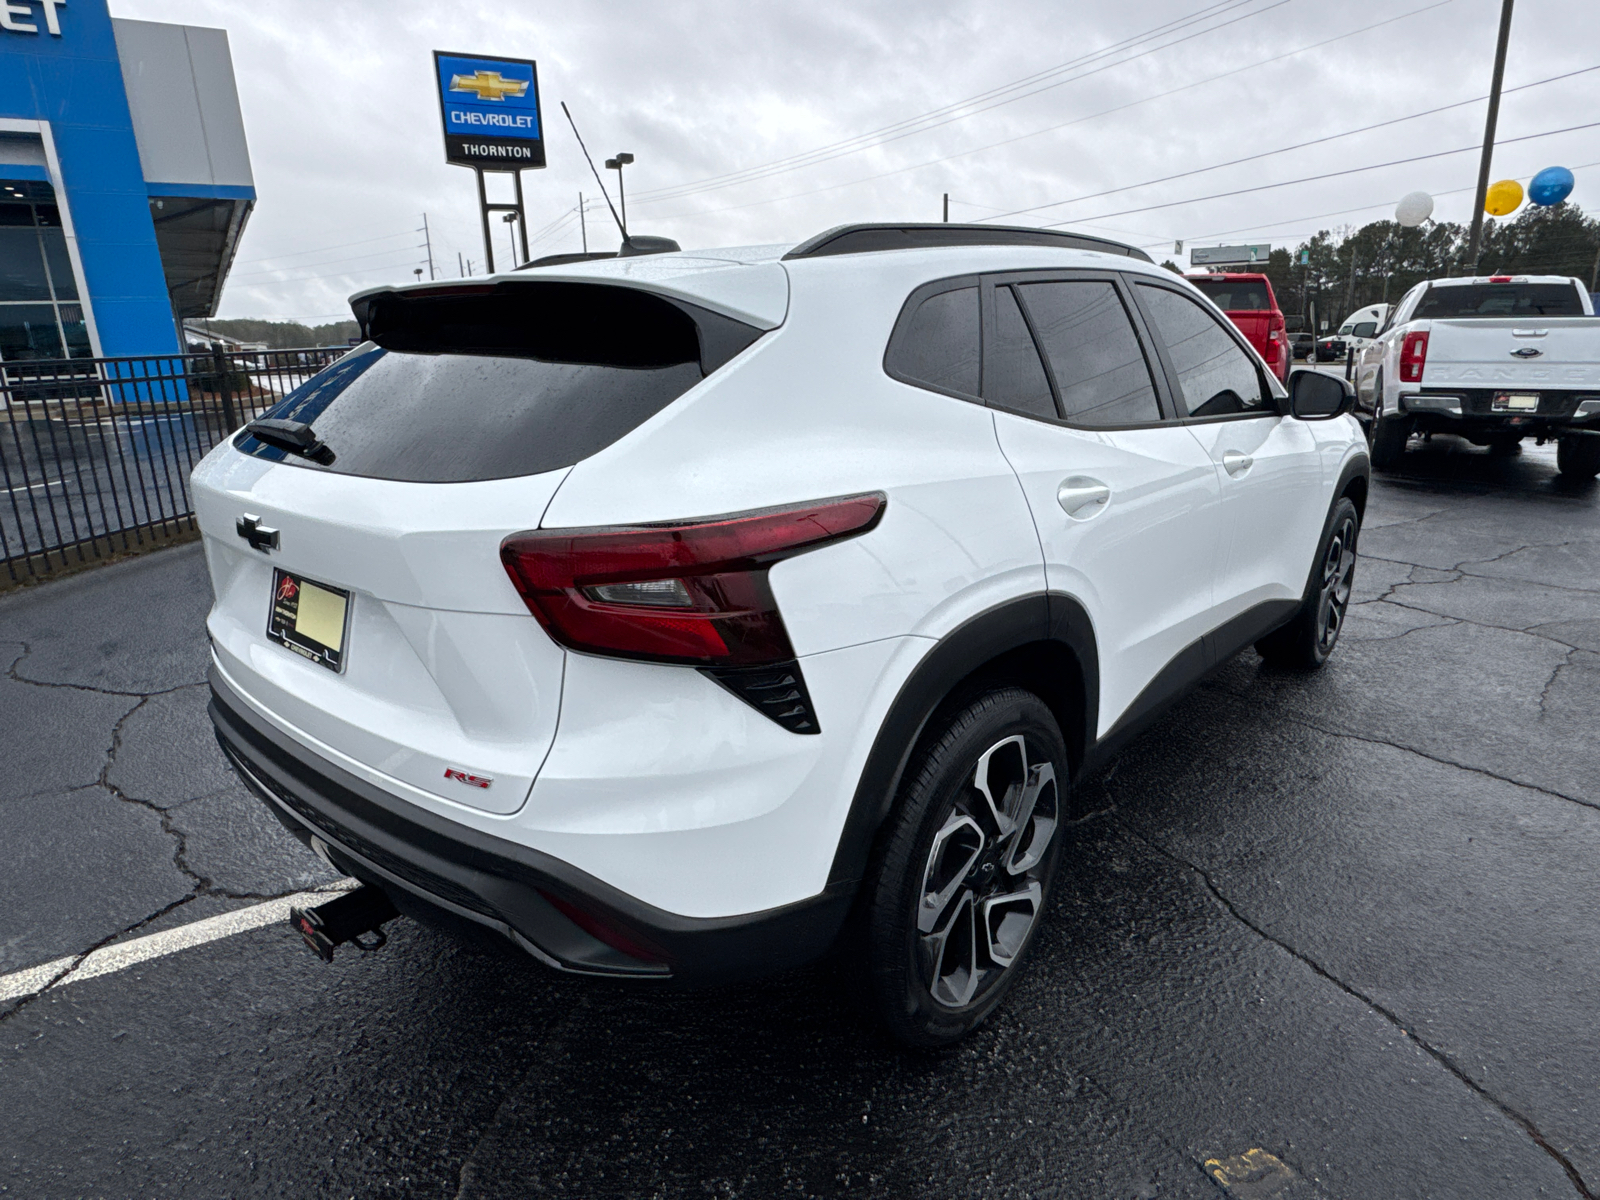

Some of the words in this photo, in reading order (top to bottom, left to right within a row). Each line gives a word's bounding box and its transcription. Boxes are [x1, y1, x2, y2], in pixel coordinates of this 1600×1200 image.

[451, 110, 533, 128] CHEVROLET
[462, 143, 532, 158] THORNTON
[1429, 366, 1600, 381] RANGE
[444, 767, 493, 789] RS
